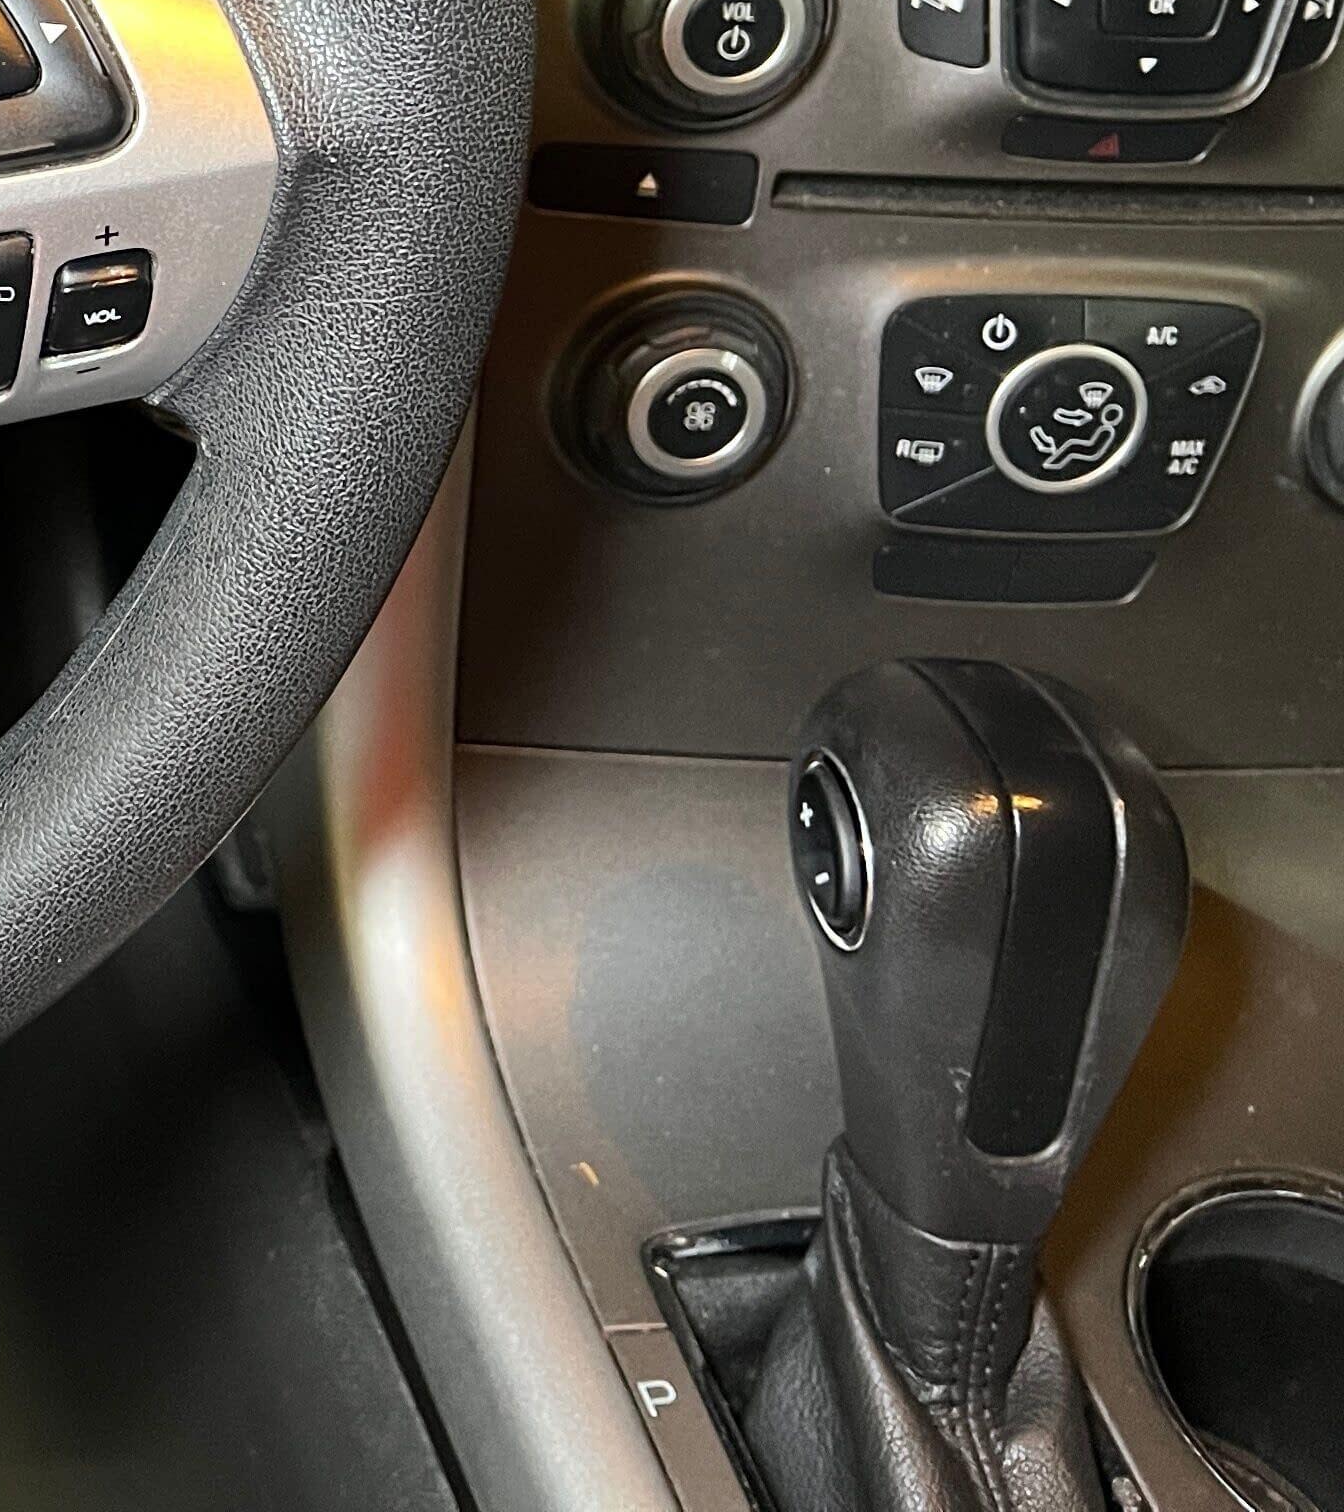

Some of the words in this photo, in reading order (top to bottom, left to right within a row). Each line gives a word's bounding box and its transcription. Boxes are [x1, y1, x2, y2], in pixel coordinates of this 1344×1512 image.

[722, 2, 756, 23] VOL
[83, 307, 122, 326] VOL
[1146, 325, 1179, 346] A/C
[1171, 440, 1206, 457] MAX
[1166, 457, 1199, 476] A/C
[637, 1379, 677, 1418] P
